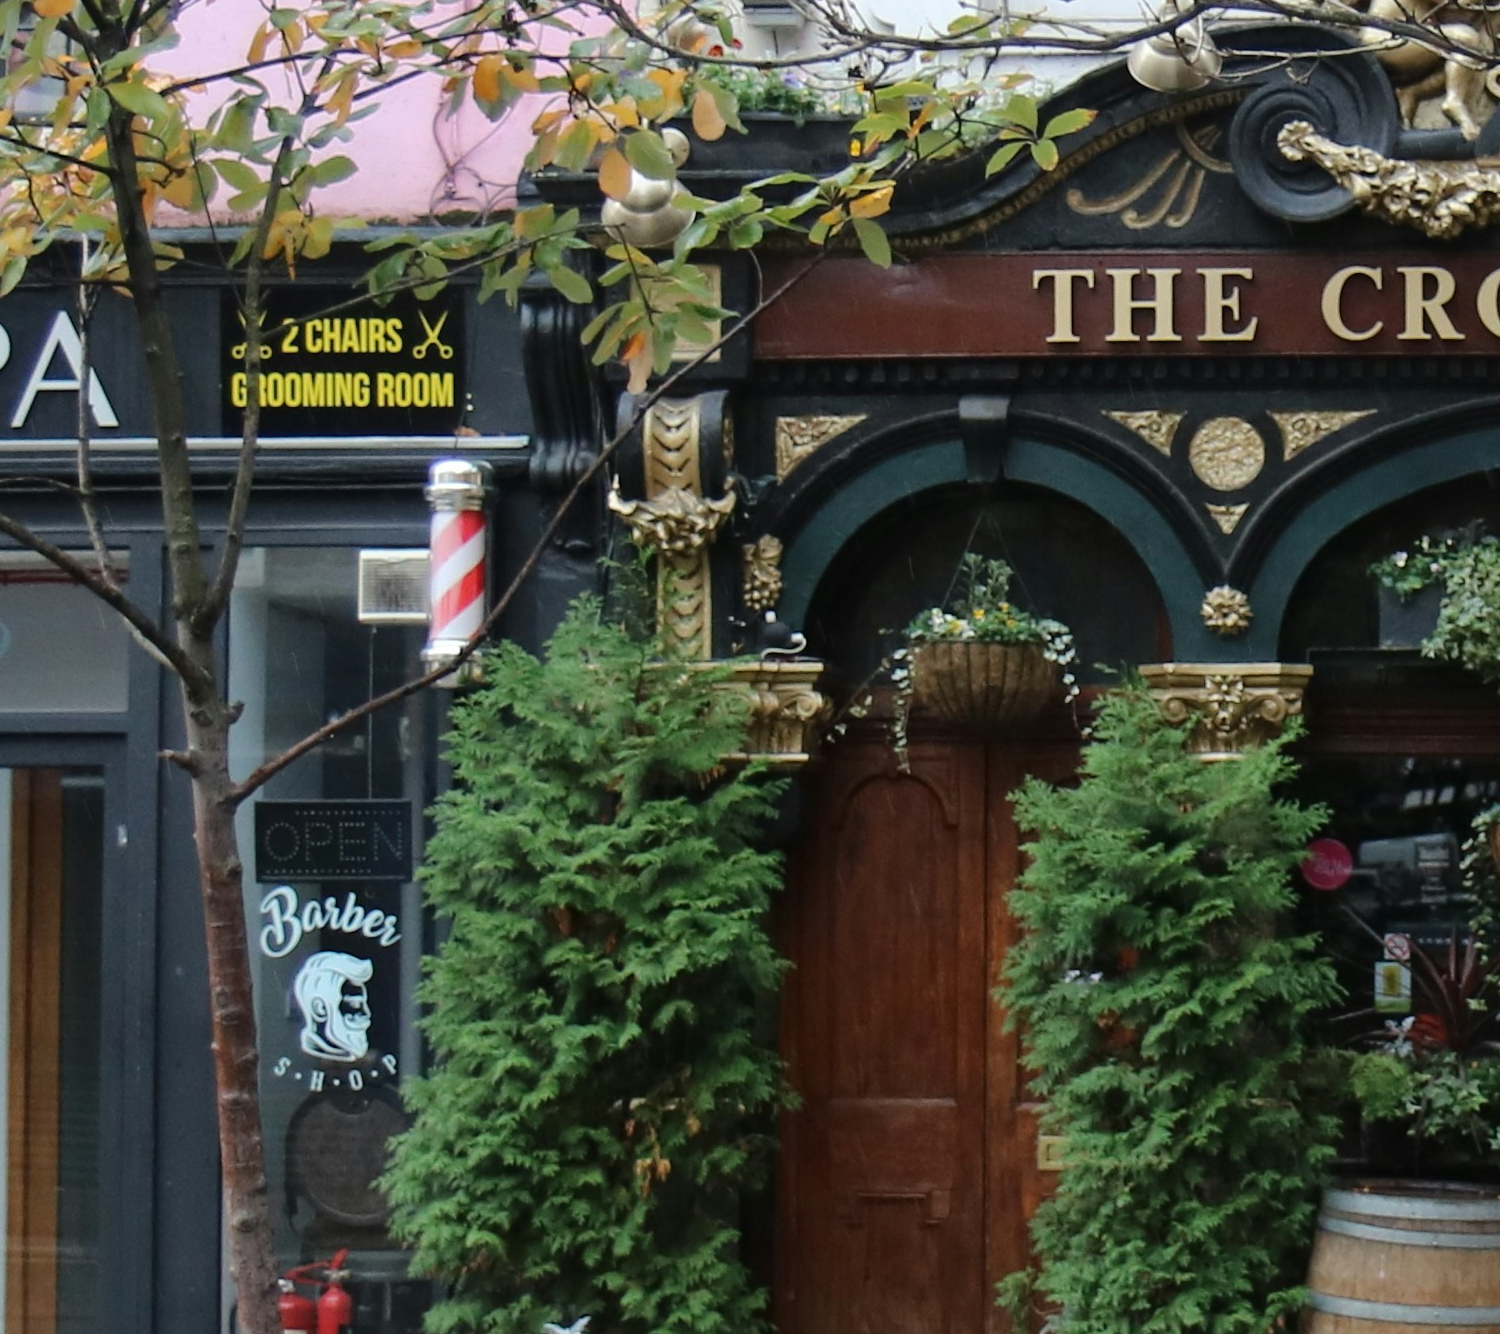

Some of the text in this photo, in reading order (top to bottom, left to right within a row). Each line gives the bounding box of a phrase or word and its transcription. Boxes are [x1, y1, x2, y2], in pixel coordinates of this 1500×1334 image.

[1033, 267, 1258, 343] THE
[281, 317, 403, 353] 2 CHAIRS
[231, 372, 454, 408] GROOMING ROOM
[266, 822, 402, 861] OPEN
[260, 885, 402, 958] Barber
